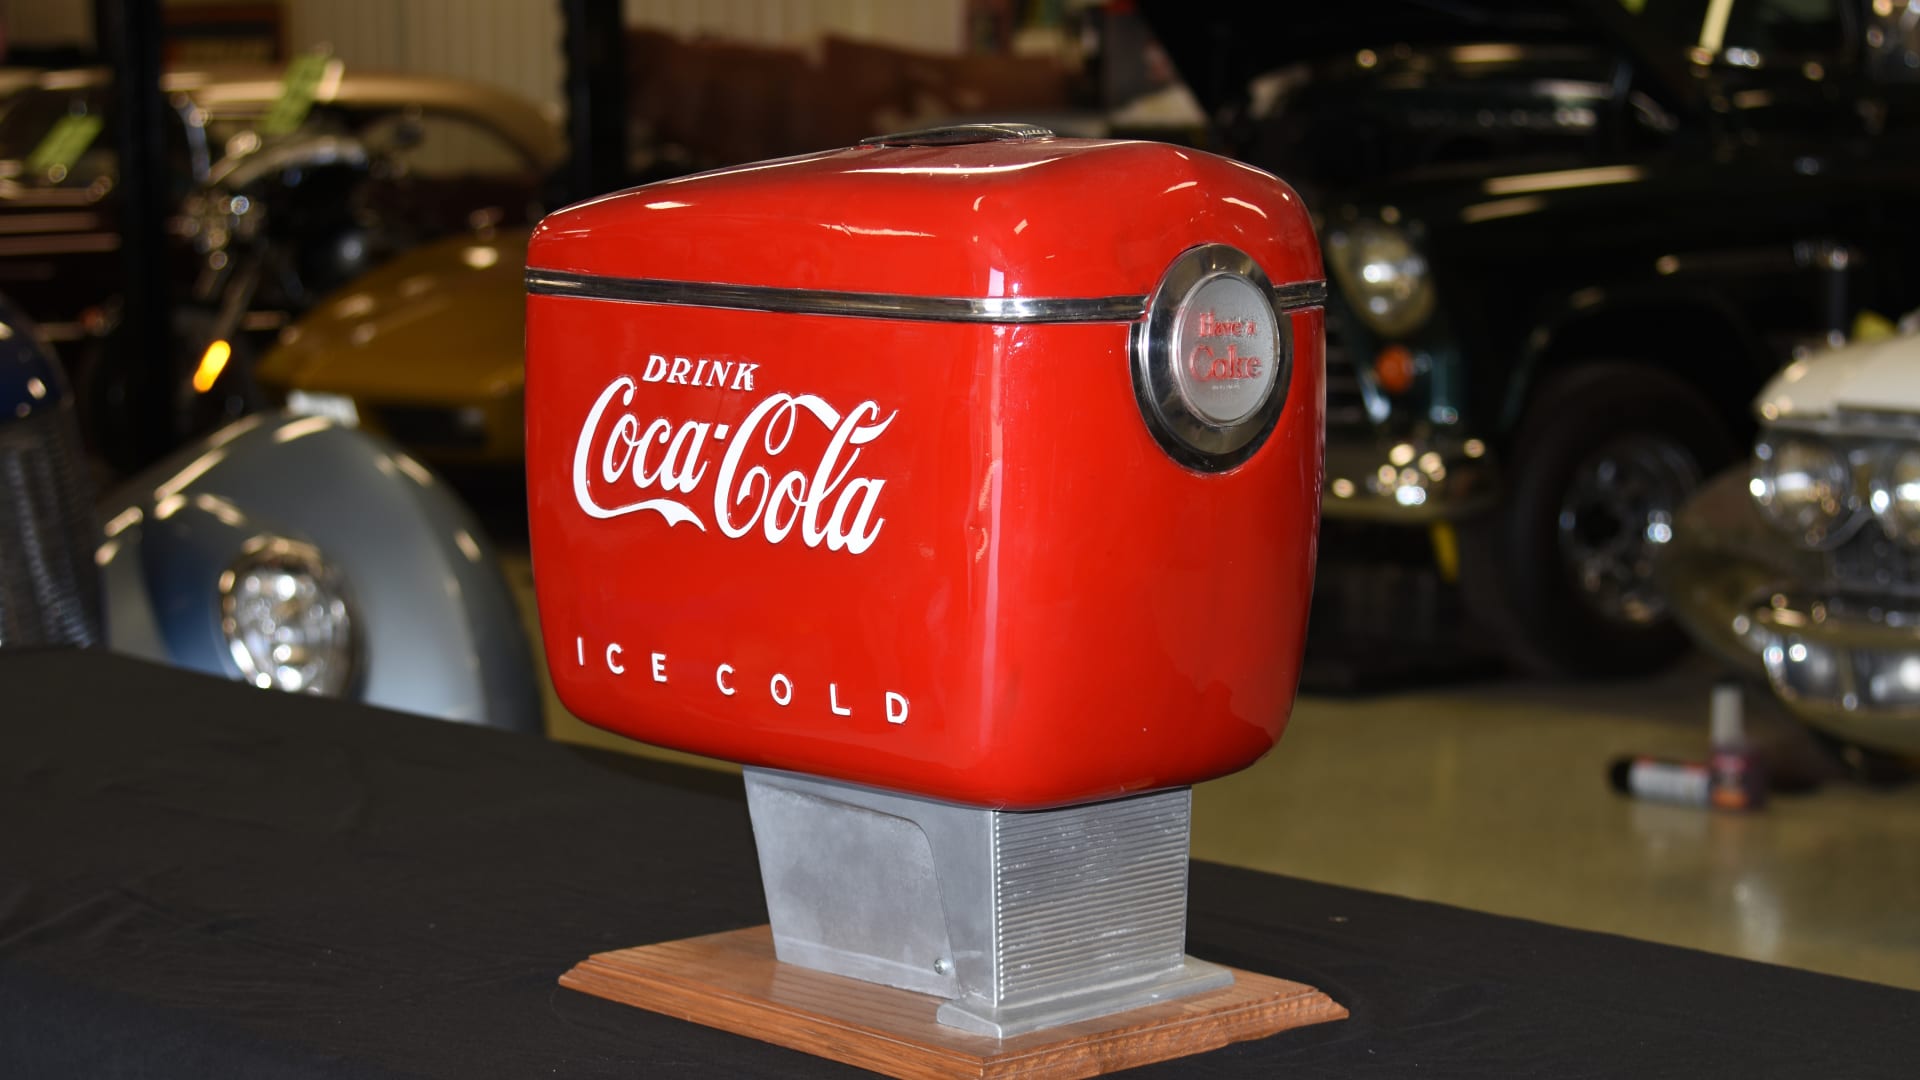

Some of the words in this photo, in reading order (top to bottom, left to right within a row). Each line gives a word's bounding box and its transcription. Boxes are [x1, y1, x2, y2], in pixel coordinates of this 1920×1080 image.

[1199, 310, 1243, 337] Have
[1246, 320, 1257, 337] a
[643, 355, 759, 391] DRINK
[1189, 344, 1262, 382] Coke
[573, 376, 898, 554] Coca-Cola
[577, 636, 668, 683] ICE
[716, 663, 909, 724] COLD
